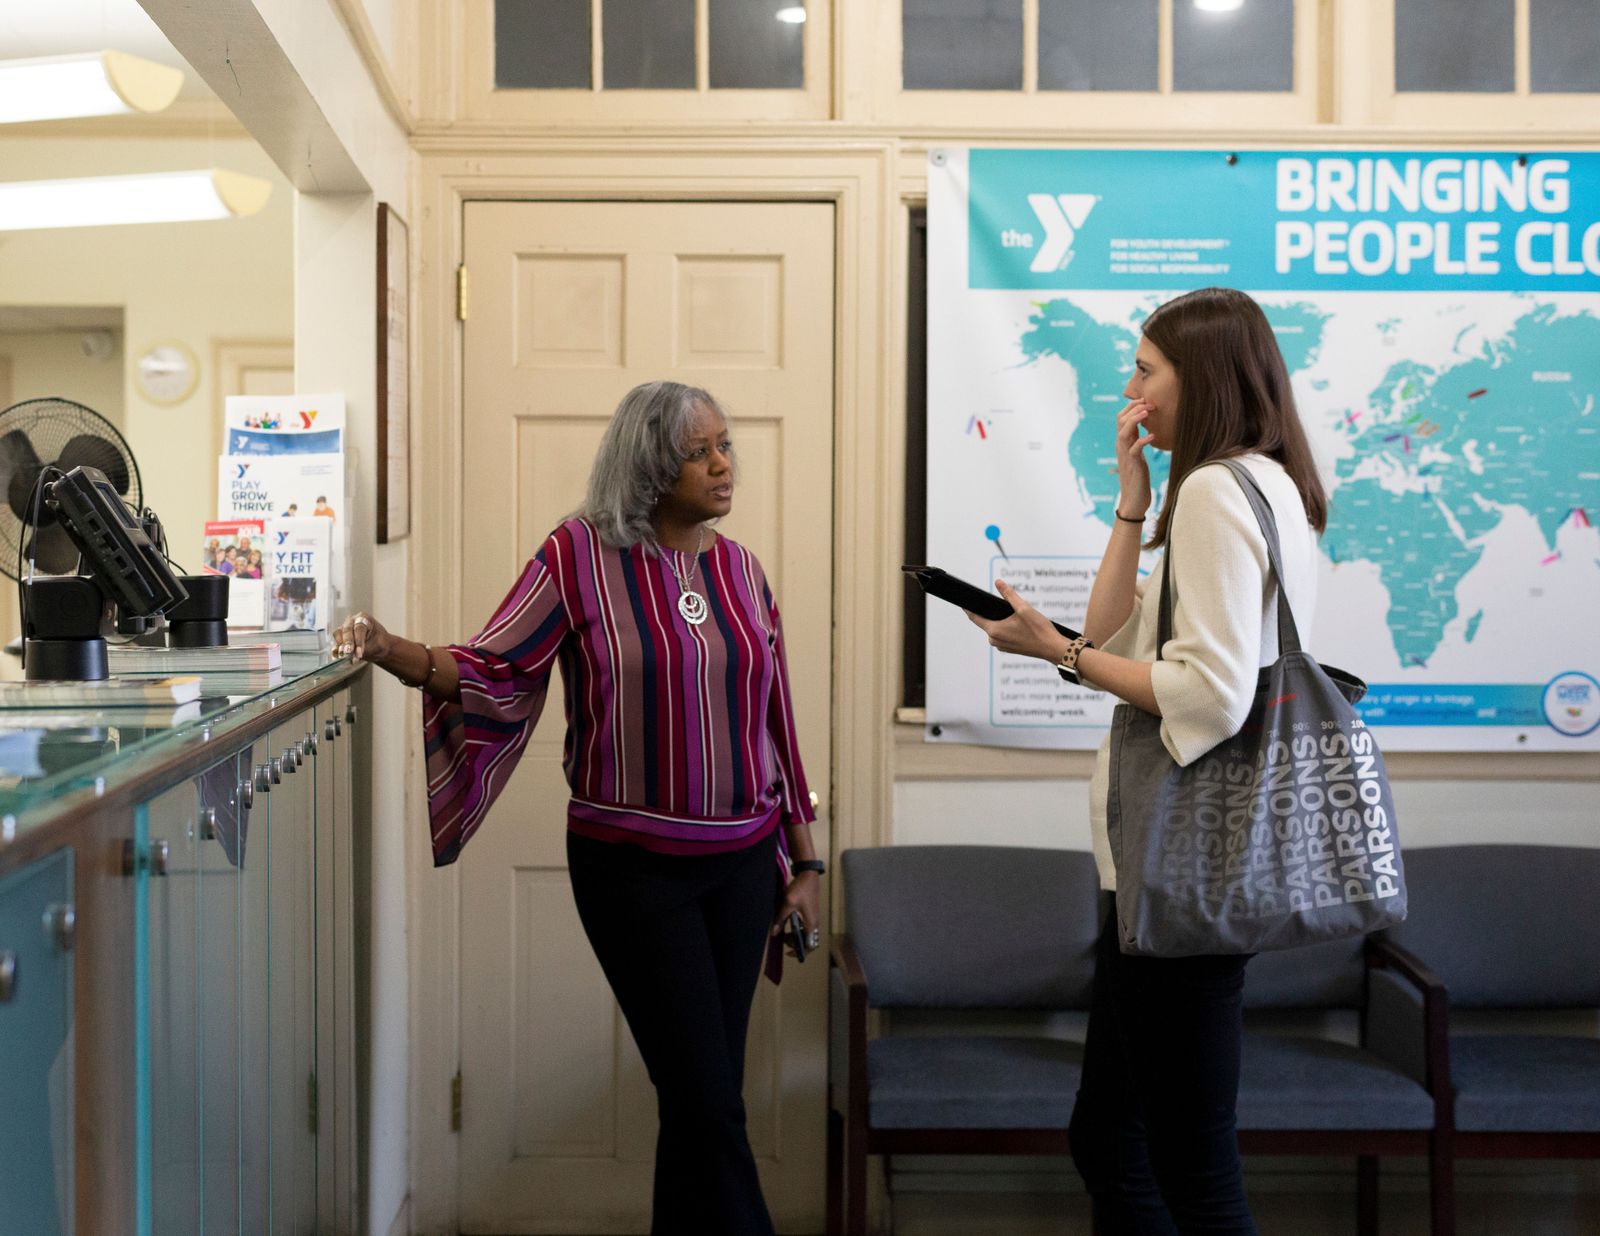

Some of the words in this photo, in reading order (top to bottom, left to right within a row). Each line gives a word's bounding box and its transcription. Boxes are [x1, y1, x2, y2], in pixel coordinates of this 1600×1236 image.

[1276, 158, 1570, 213] BRINGING
[1001, 229, 1033, 248] the
[1275, 220, 1501, 276] PEOPLE
[232, 481, 261, 491] PLAY
[231, 491, 268, 501] GROW
[232, 502, 274, 512] THRIVE
[276, 552, 286, 563] Y
[291, 552, 314, 563] FIT
[275, 564, 313, 574] START
[1034, 568, 1089, 579] Welcoming
[1291, 734, 1343, 909] PARSONS
[1320, 732, 1375, 903] PARSONS
[1351, 730, 1399, 900] PARSONS
[1267, 740, 1313, 913] PARSONS
